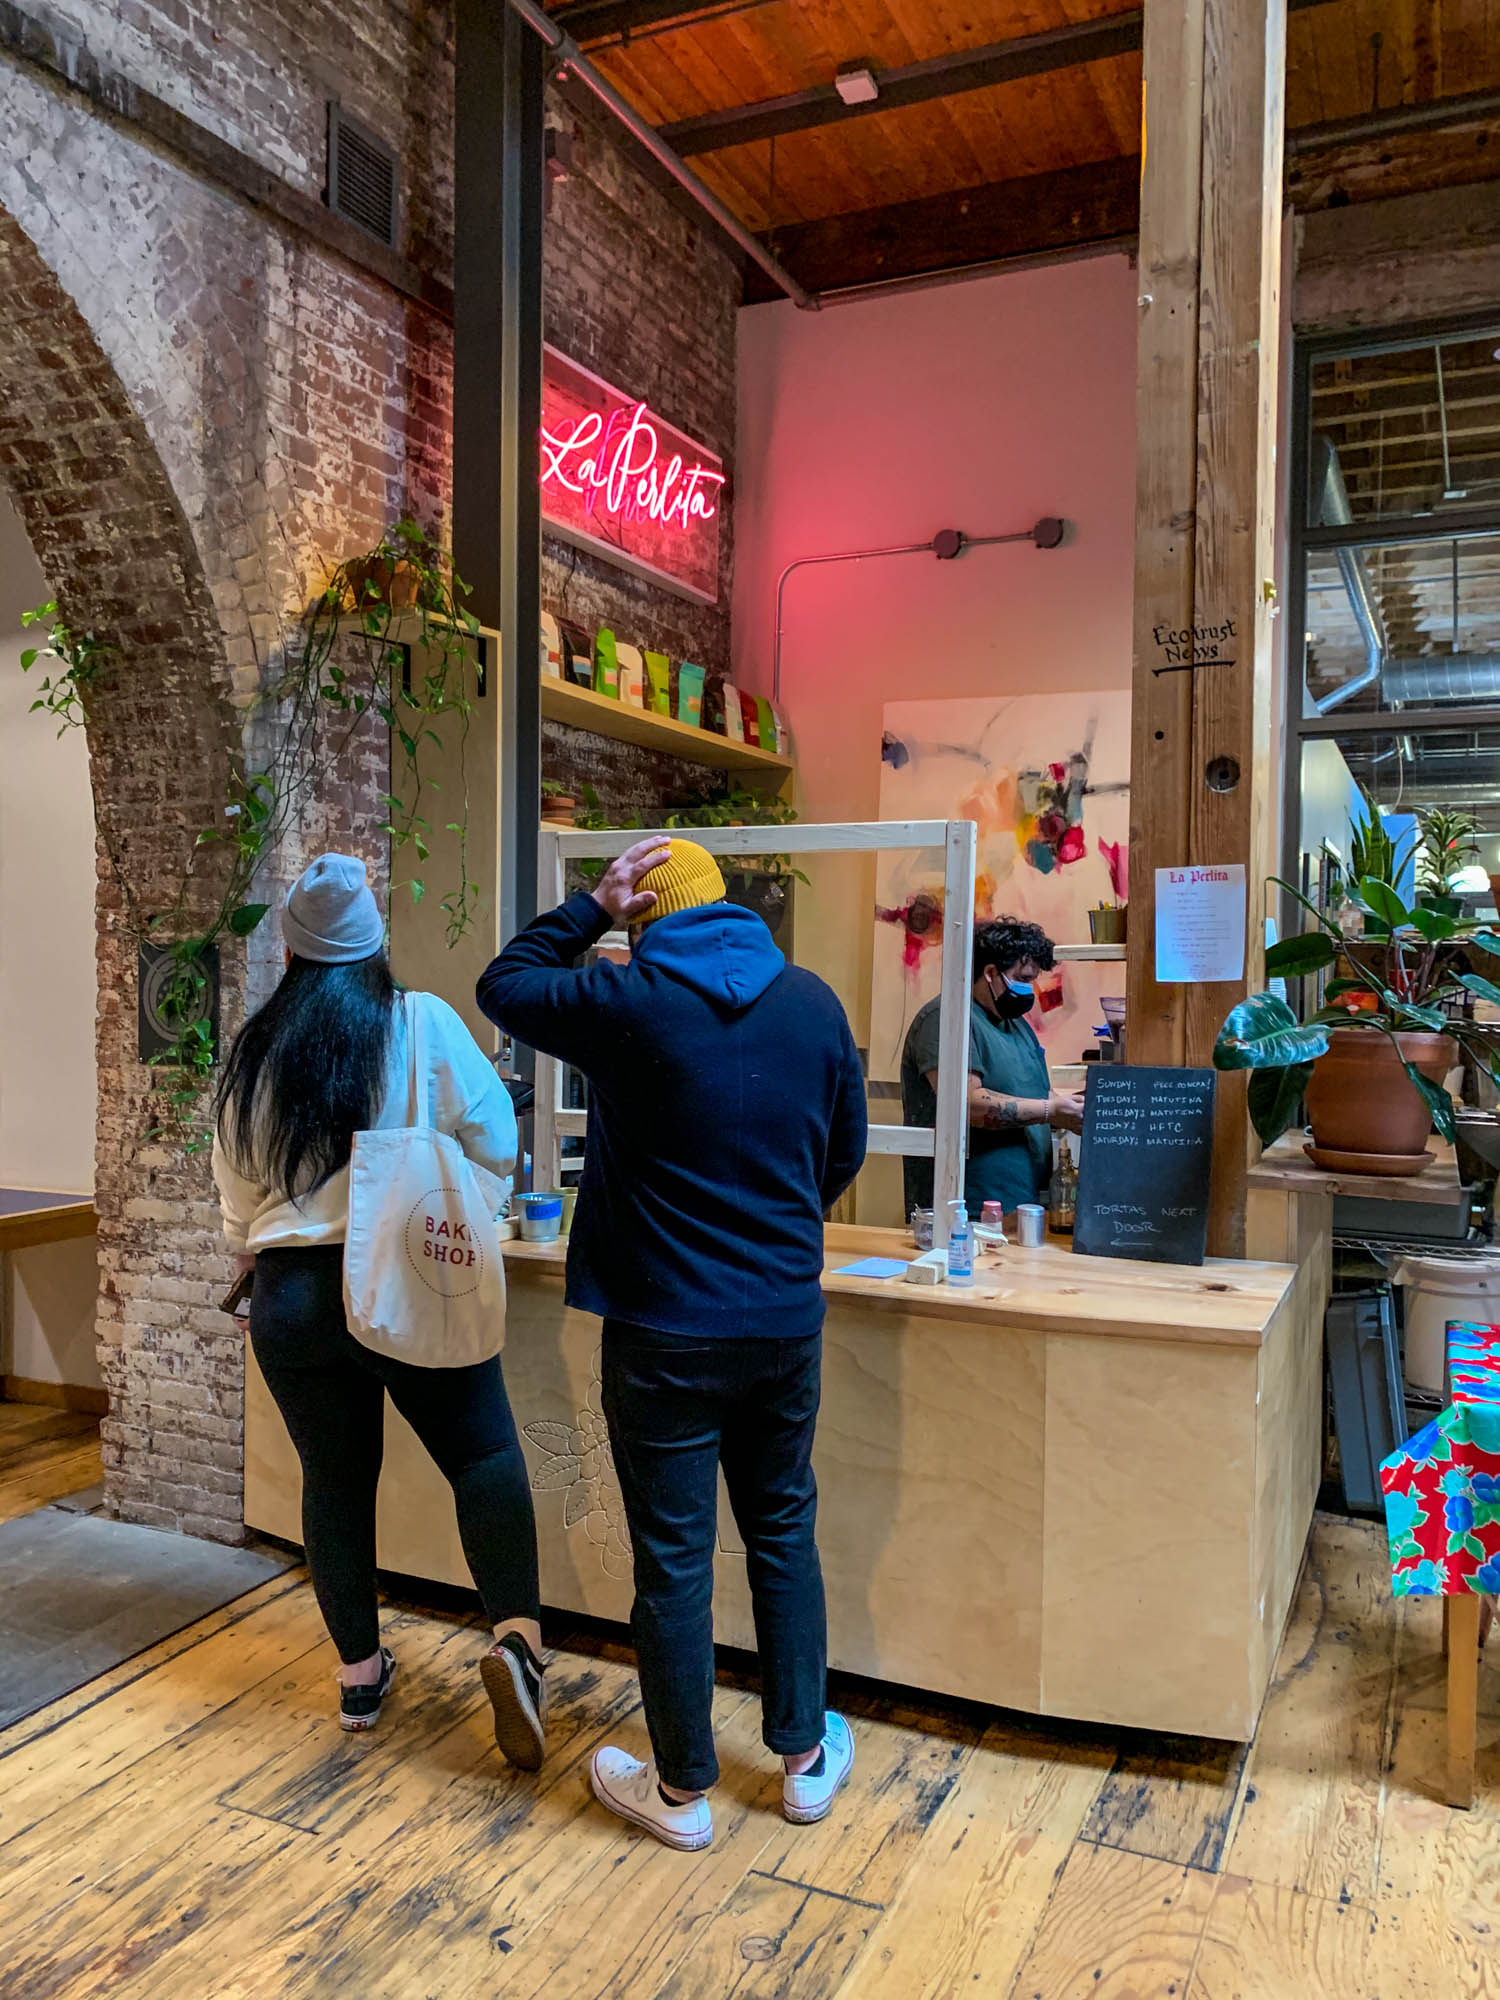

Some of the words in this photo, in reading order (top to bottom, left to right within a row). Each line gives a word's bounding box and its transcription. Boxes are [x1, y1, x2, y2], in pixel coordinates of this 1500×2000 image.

[540, 412, 608, 493] La
[607, 402, 726, 529] Perlita
[1152, 619, 1237, 645] Ecotrust
[1165, 645, 1218, 663] News
[1169, 871, 1185, 884] La
[1190, 869, 1229, 884] Perlita
[1096, 1078, 1137, 1091] SUNDAY:
[1096, 1095, 1137, 1104] TUESDAY:
[1150, 1095, 1202, 1104] MATUTINA
[1096, 1108, 1145, 1119] THURSDAY:
[1095, 1122, 1136, 1131] FRIDAY:
[1093, 1204, 1148, 1215] TORTAS
[1161, 1207, 1198, 1217] NEXT
[425, 1215, 472, 1242] BAK
[1113, 1221, 1162, 1233] DOOR
